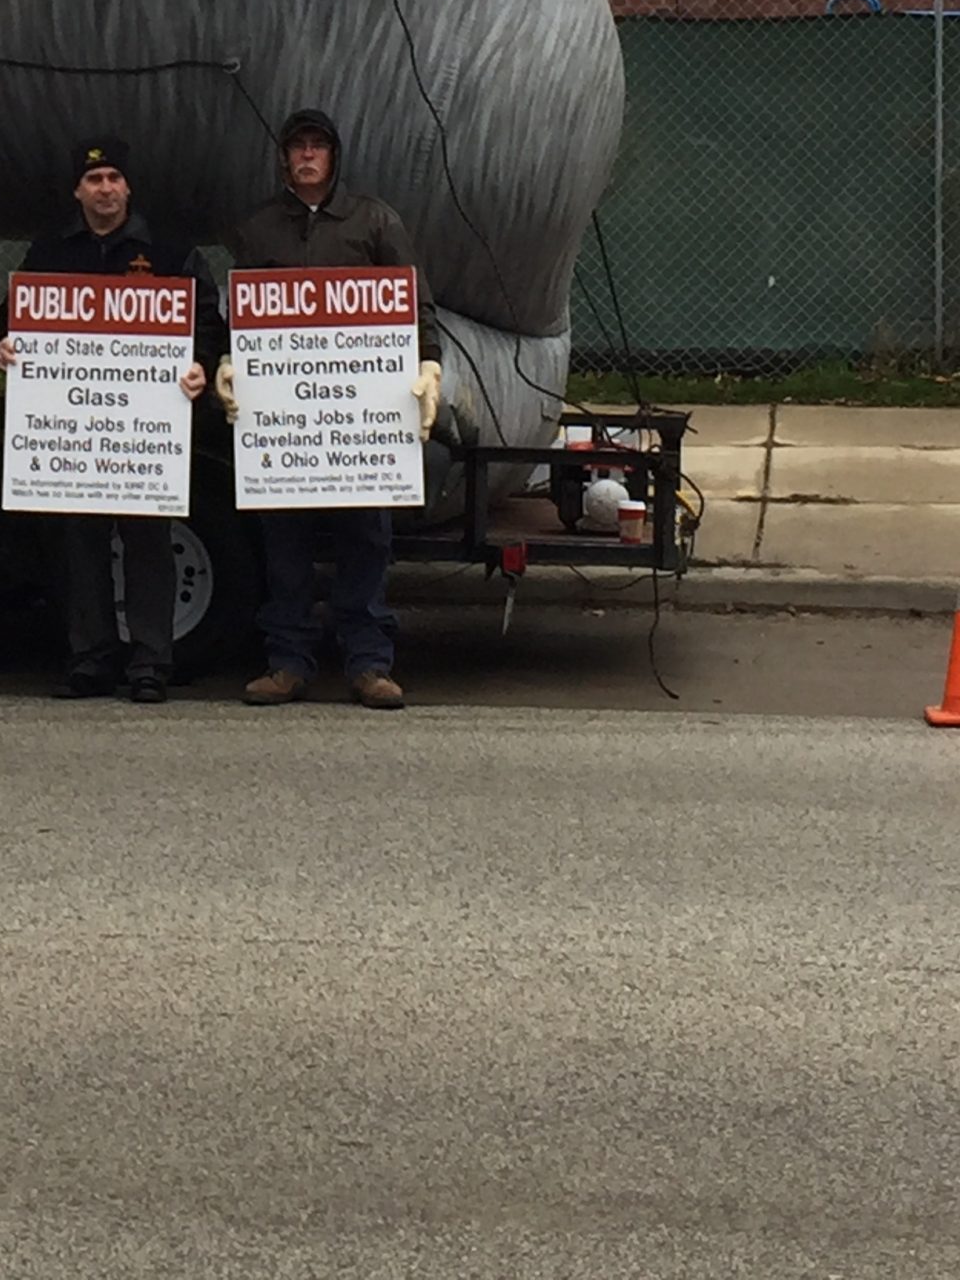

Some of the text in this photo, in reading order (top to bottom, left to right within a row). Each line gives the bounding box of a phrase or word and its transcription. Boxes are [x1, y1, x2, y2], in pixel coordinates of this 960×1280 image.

[15, 285, 186, 323] PUBLIC NOTICE
[236, 278, 409, 316] PUBLIC NOTICE
[13, 336, 186, 358] Out of State Contractor
[236, 331, 411, 352] Out of State Contractor
[21, 361, 177, 383] Environmental
[246, 355, 403, 376] Environmental
[67, 386, 128, 407] Glass
[294, 381, 356, 400] Glass
[24, 413, 171, 434] Taking Jobs from
[252, 408, 401, 429] Taking Jobs from
[11, 434, 182, 455] Cleveland Residents
[241, 429, 414, 448] Cleveland Residents
[29, 456, 163, 475] & Ohio Workers
[260, 450, 396, 468] & Ohio Workers
